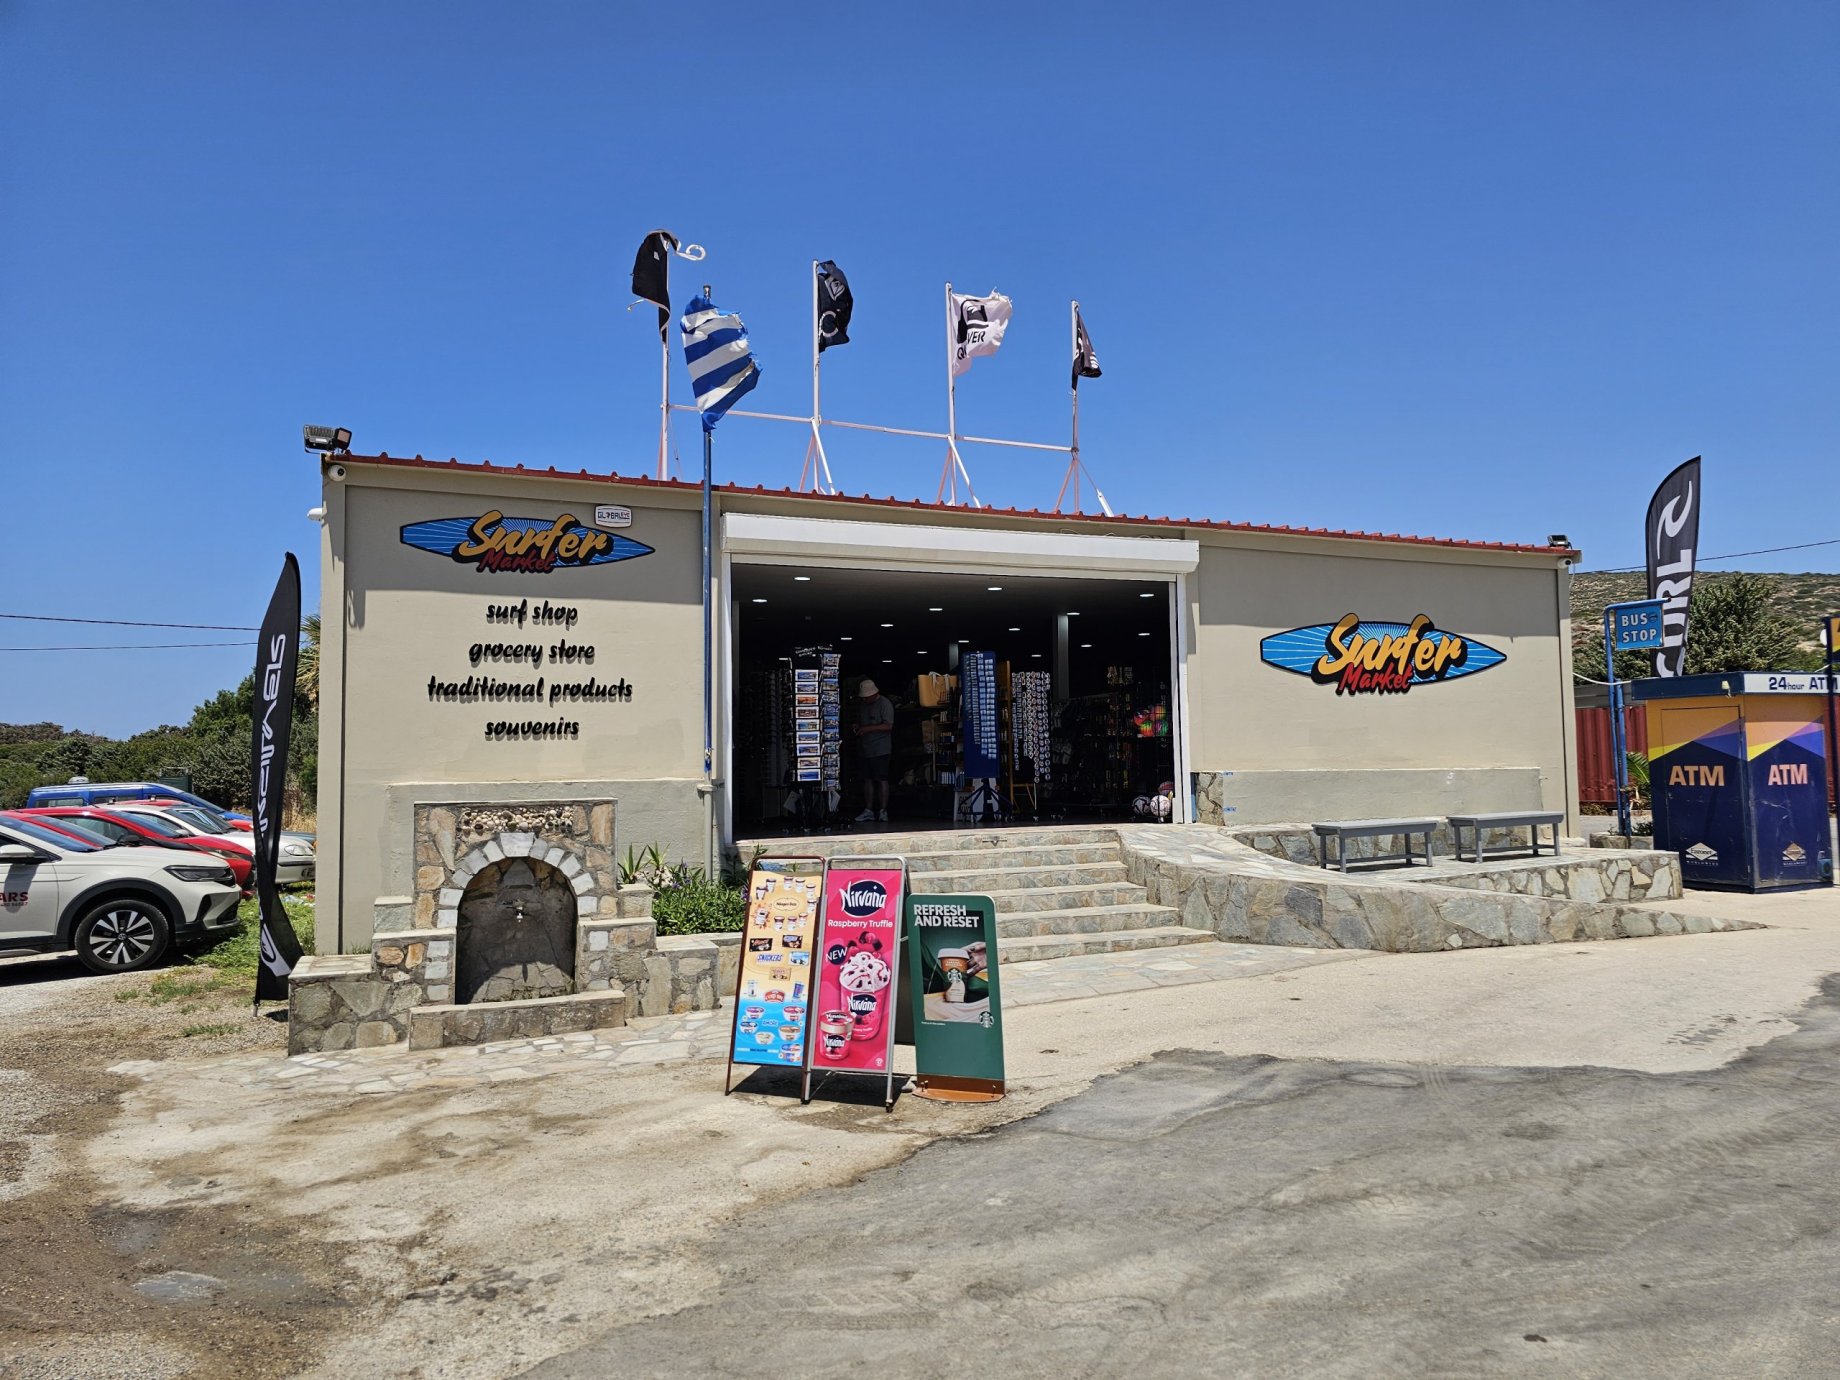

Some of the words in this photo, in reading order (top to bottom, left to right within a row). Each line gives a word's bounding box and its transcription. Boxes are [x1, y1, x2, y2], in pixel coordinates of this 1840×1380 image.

[456, 510, 610, 560] Surfer
[478, 549, 557, 572] Market
[486, 599, 527, 623] surf
[532, 600, 578, 625] shop
[1621, 613, 1648, 627] BUS
[1317, 613, 1464, 676] Surfer
[1622, 629, 1657, 643] STOP
[469, 642, 543, 663] grocery
[549, 639, 595, 659] store
[1338, 662, 1413, 691] Market
[428, 675, 544, 698] traditional
[549, 677, 633, 703] products
[484, 717, 580, 737] souvenirs
[1668, 765, 1725, 787] ATM
[1768, 763, 1809, 786] ATM
[839, 881, 887, 911] Nirvana
[913, 904, 967, 916] REFRESH
[828, 919, 868, 928] Raspberry
[869, 919, 894, 928] Truffle
[914, 915, 941, 927] AND
[943, 916, 980, 928] RESET
[826, 946, 848, 962] NEW
[847, 993, 877, 1012] Nirvana
